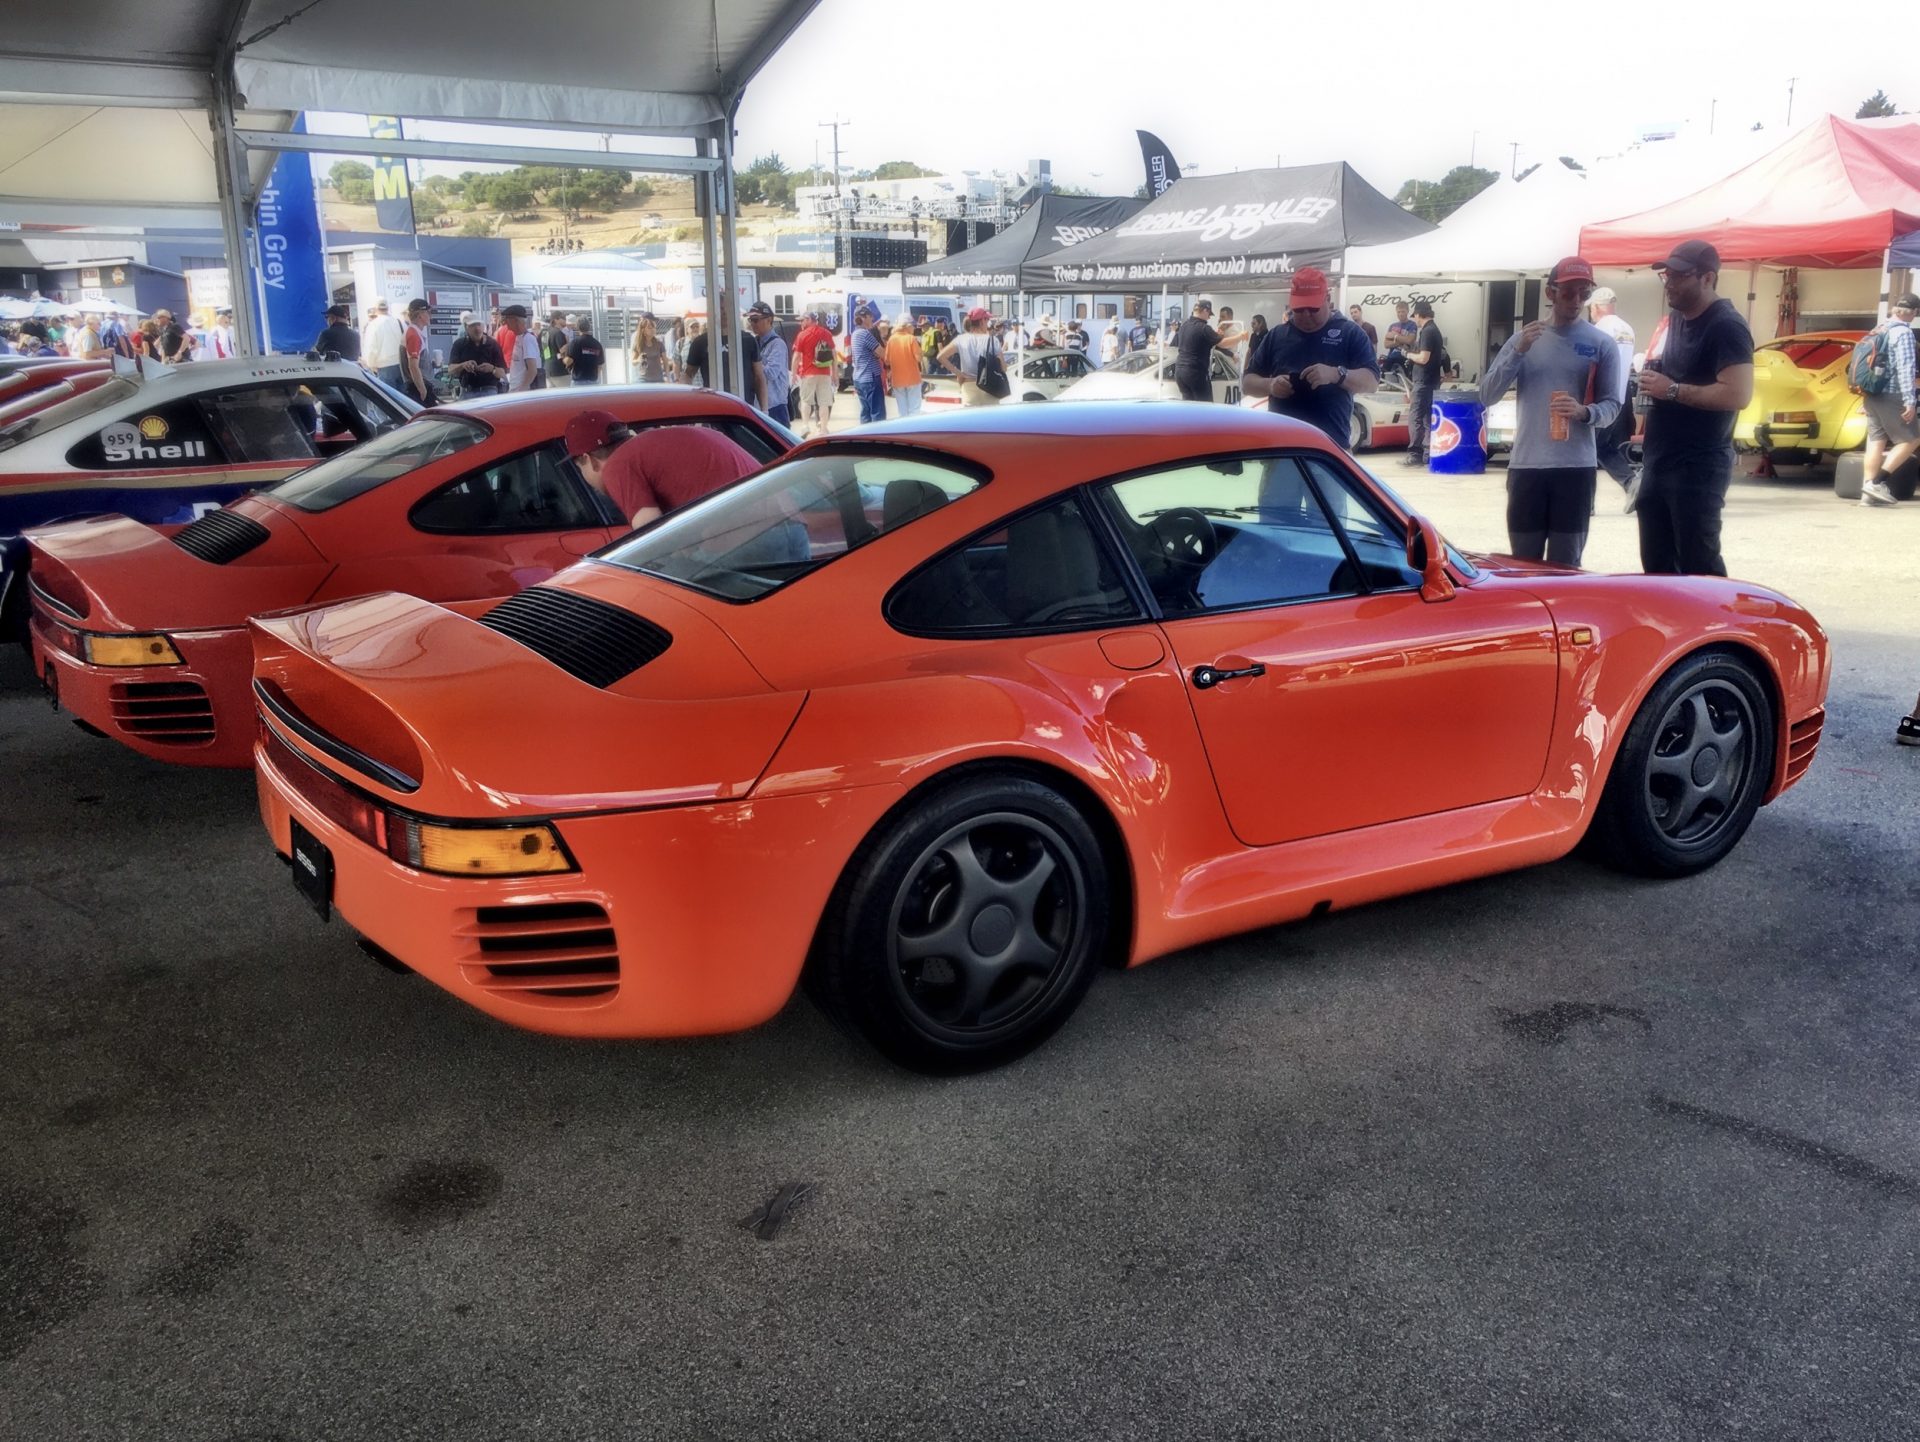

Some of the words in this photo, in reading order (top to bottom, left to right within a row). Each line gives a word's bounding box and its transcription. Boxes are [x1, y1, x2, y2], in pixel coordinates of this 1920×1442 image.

[1151, 155, 1162, 197] RAILER
[1131, 208, 1203, 231] BRING
[1230, 197, 1337, 221] TRAILER
[264, 234, 288, 290] Grey
[1053, 265, 1079, 283] This
[1081, 266, 1094, 281] is
[1097, 262, 1126, 281] how
[1129, 259, 1190, 279] auctions
[1194, 255, 1246, 276] should
[1249, 253, 1295, 274] work.
[656, 282, 683, 296] Ryder
[905, 271, 1016, 290] www.bringatrailer.com
[1360, 293, 1402, 306] Retro
[1407, 291, 1453, 308] Sport
[280, 366, 325, 374] METGE
[107, 433, 134, 446] 959
[104, 441, 206, 462] Shell
